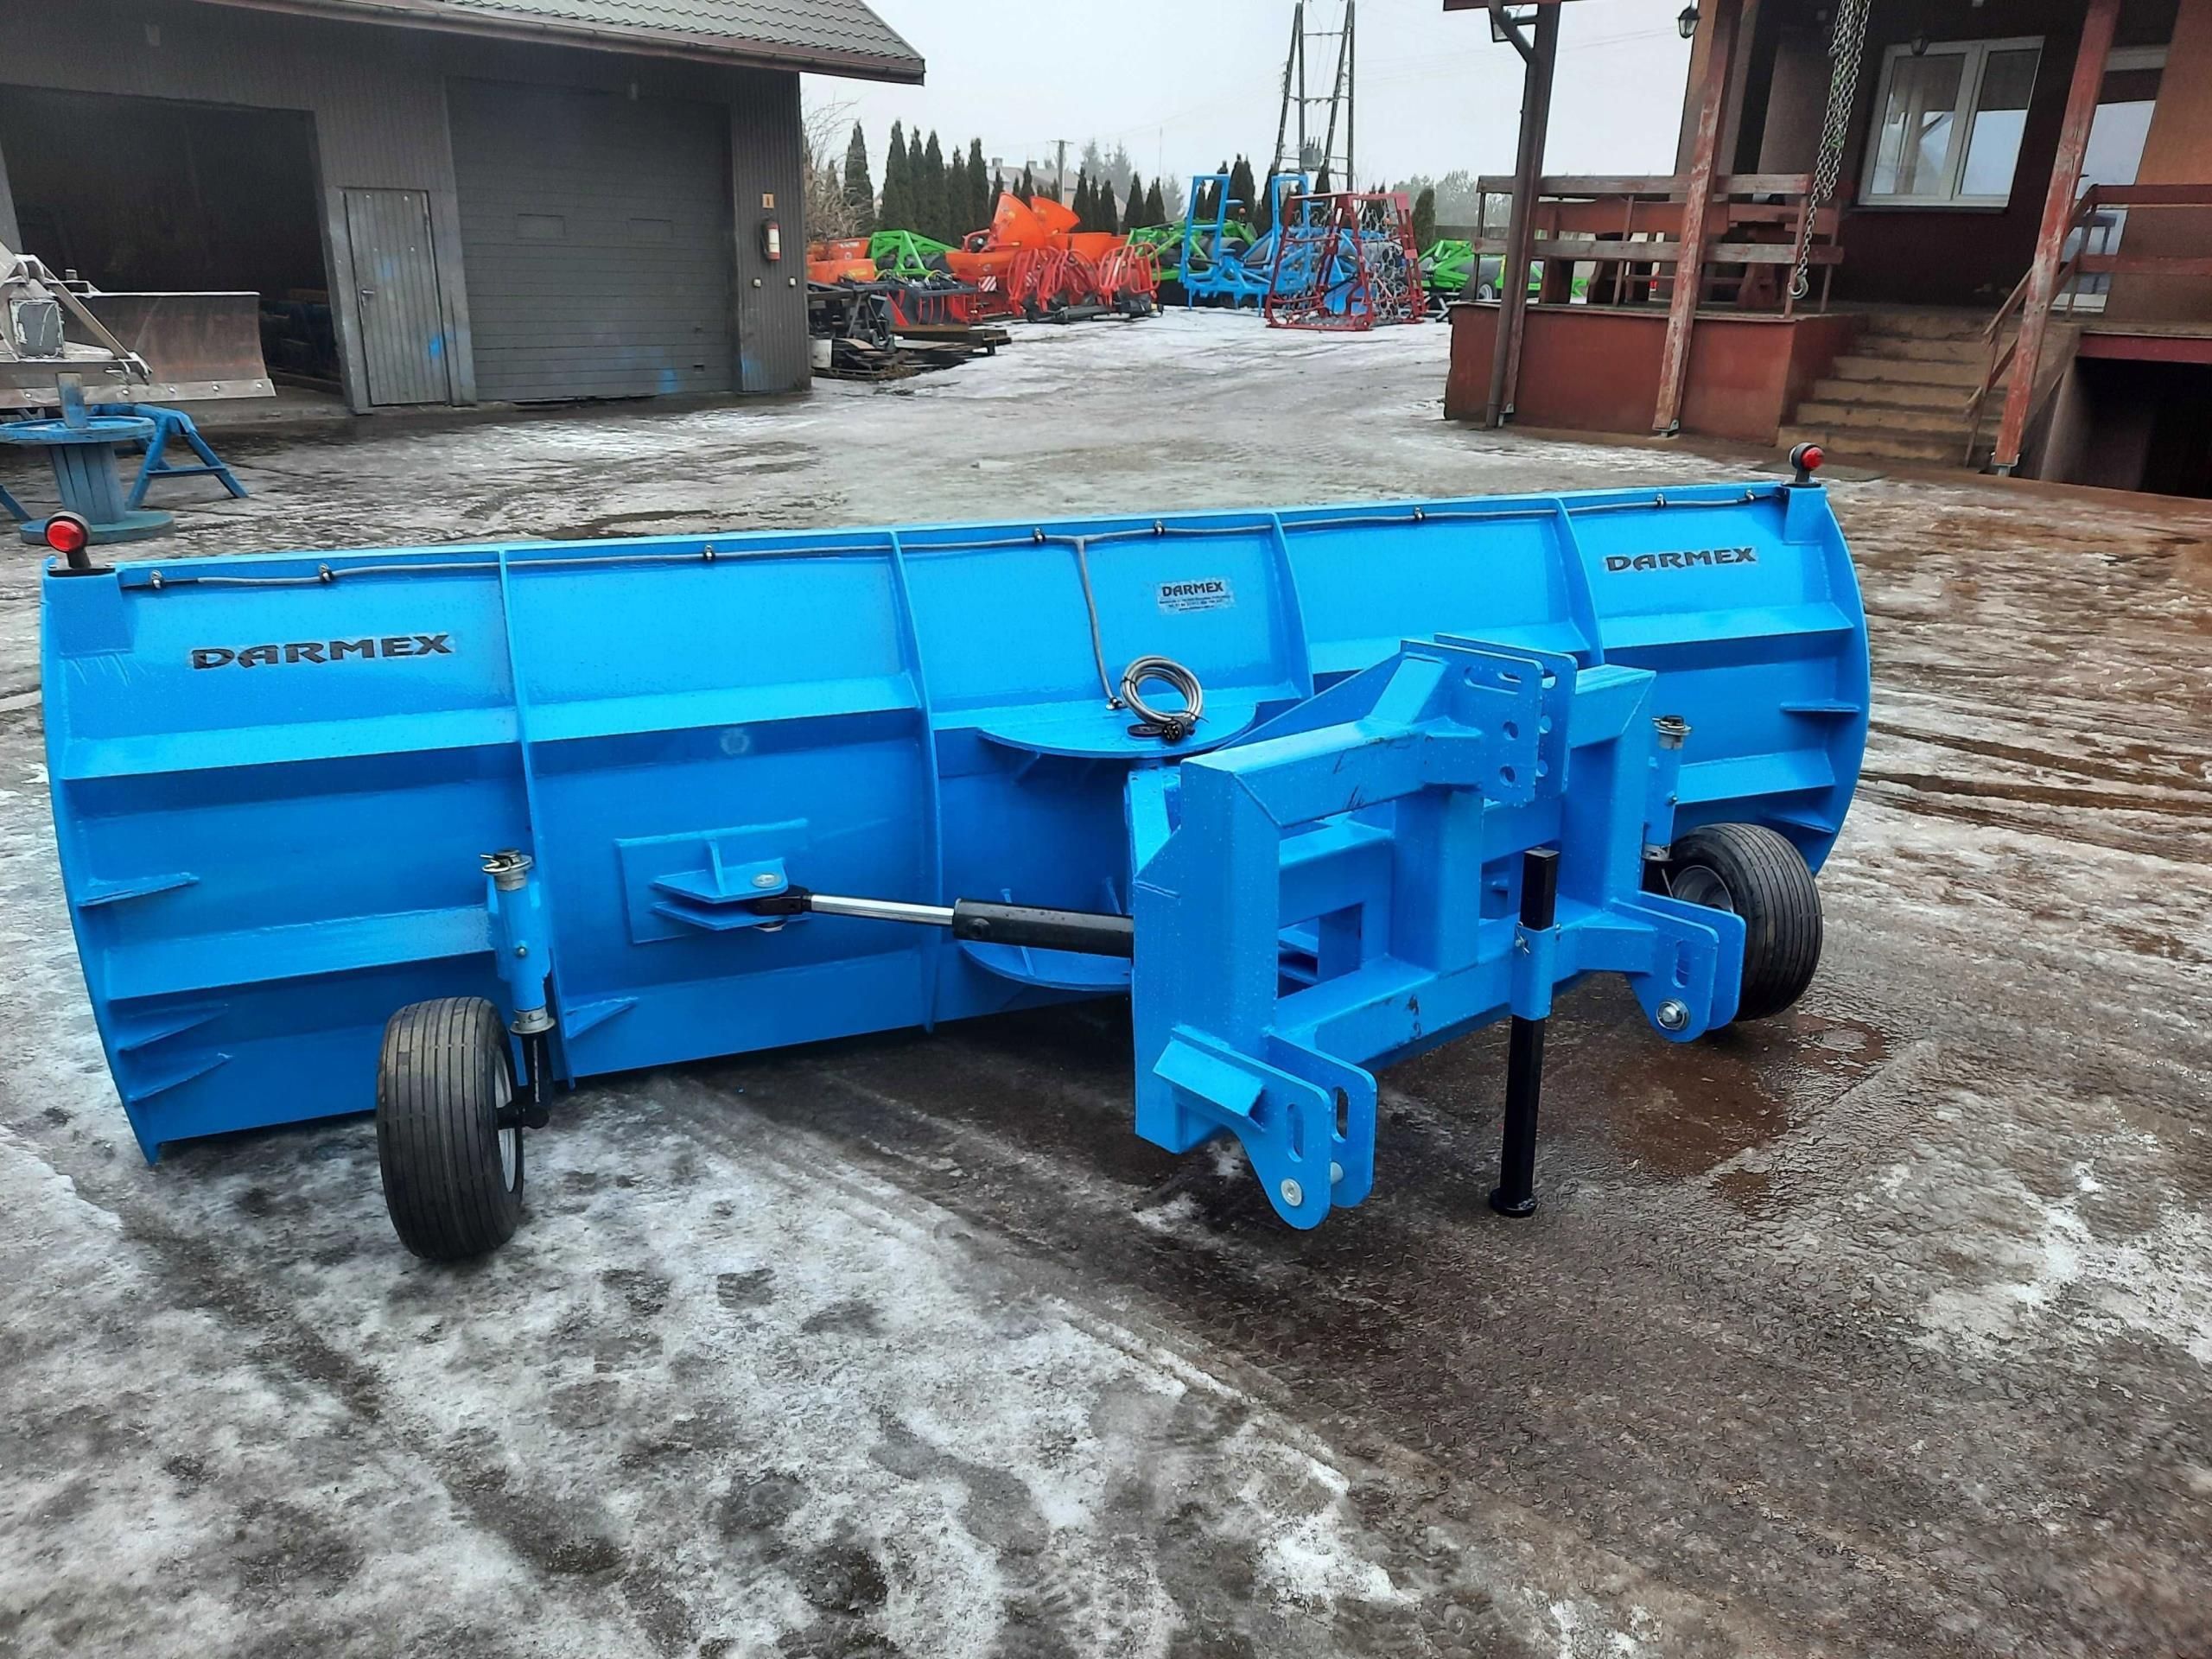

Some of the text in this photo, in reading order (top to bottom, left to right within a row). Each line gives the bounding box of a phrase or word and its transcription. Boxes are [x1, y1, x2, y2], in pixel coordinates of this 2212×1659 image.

[1605, 547, 1757, 571] DARMEX
[1161, 582, 1224, 597] DARMEX
[192, 634, 452, 670] DARMEX
